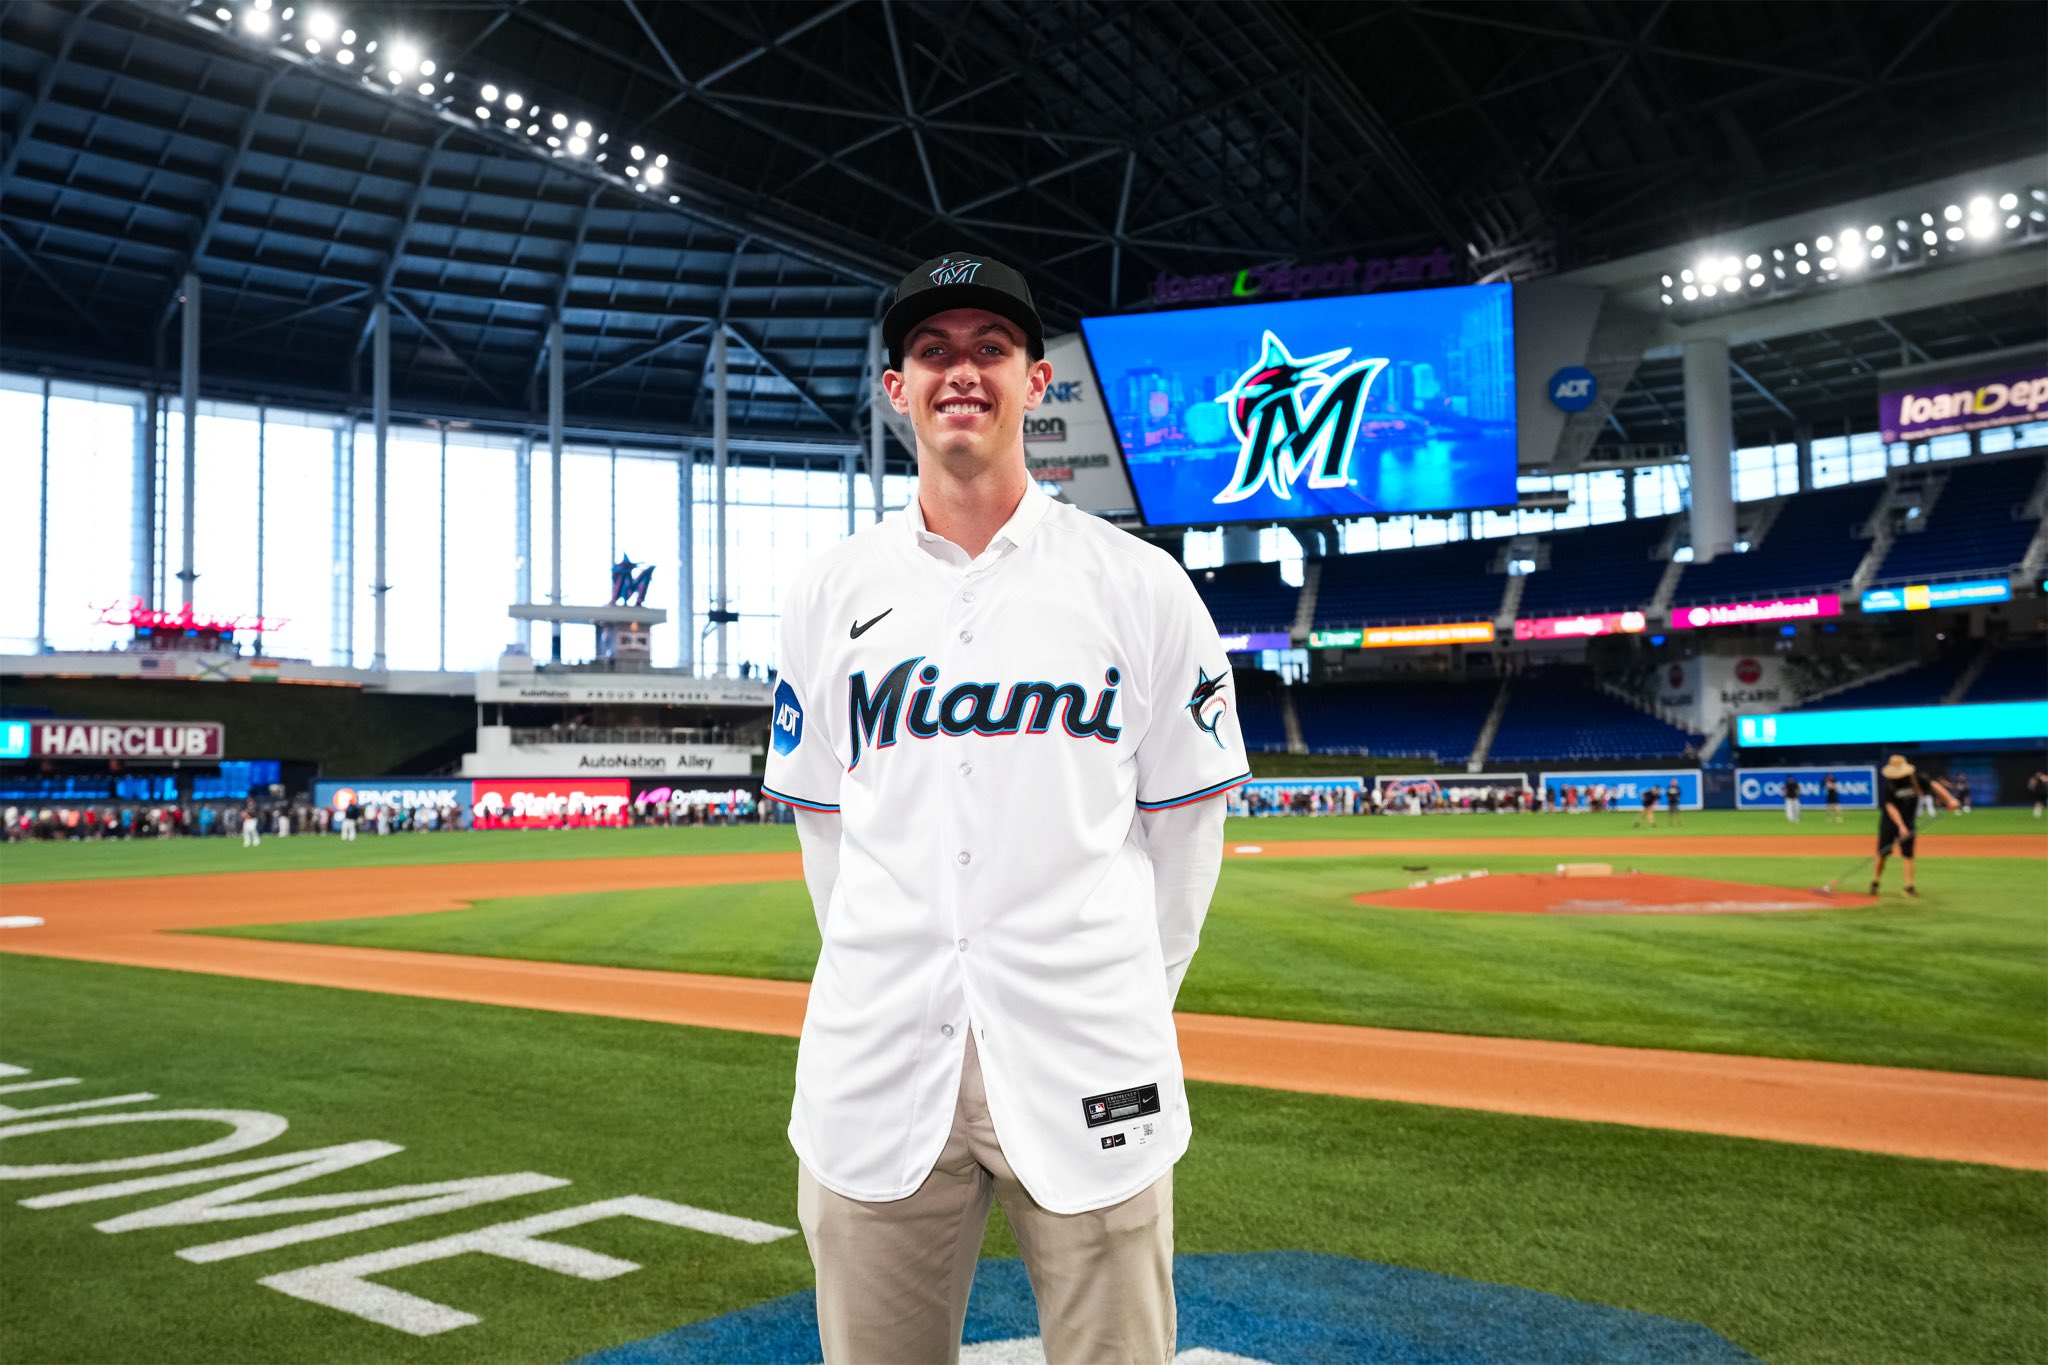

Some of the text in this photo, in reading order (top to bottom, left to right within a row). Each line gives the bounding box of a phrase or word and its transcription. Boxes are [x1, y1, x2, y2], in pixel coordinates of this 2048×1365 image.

[1362, 246, 1453, 293] park
[1555, 378, 1591, 398] ADT
[776, 702, 800, 737] ADT
[848, 656, 1122, 773] Miami
[41, 725, 208, 755] HAIRCLUB
[579, 754, 714, 770] AutoNation Alley
[402, 789, 457, 808] BANK
